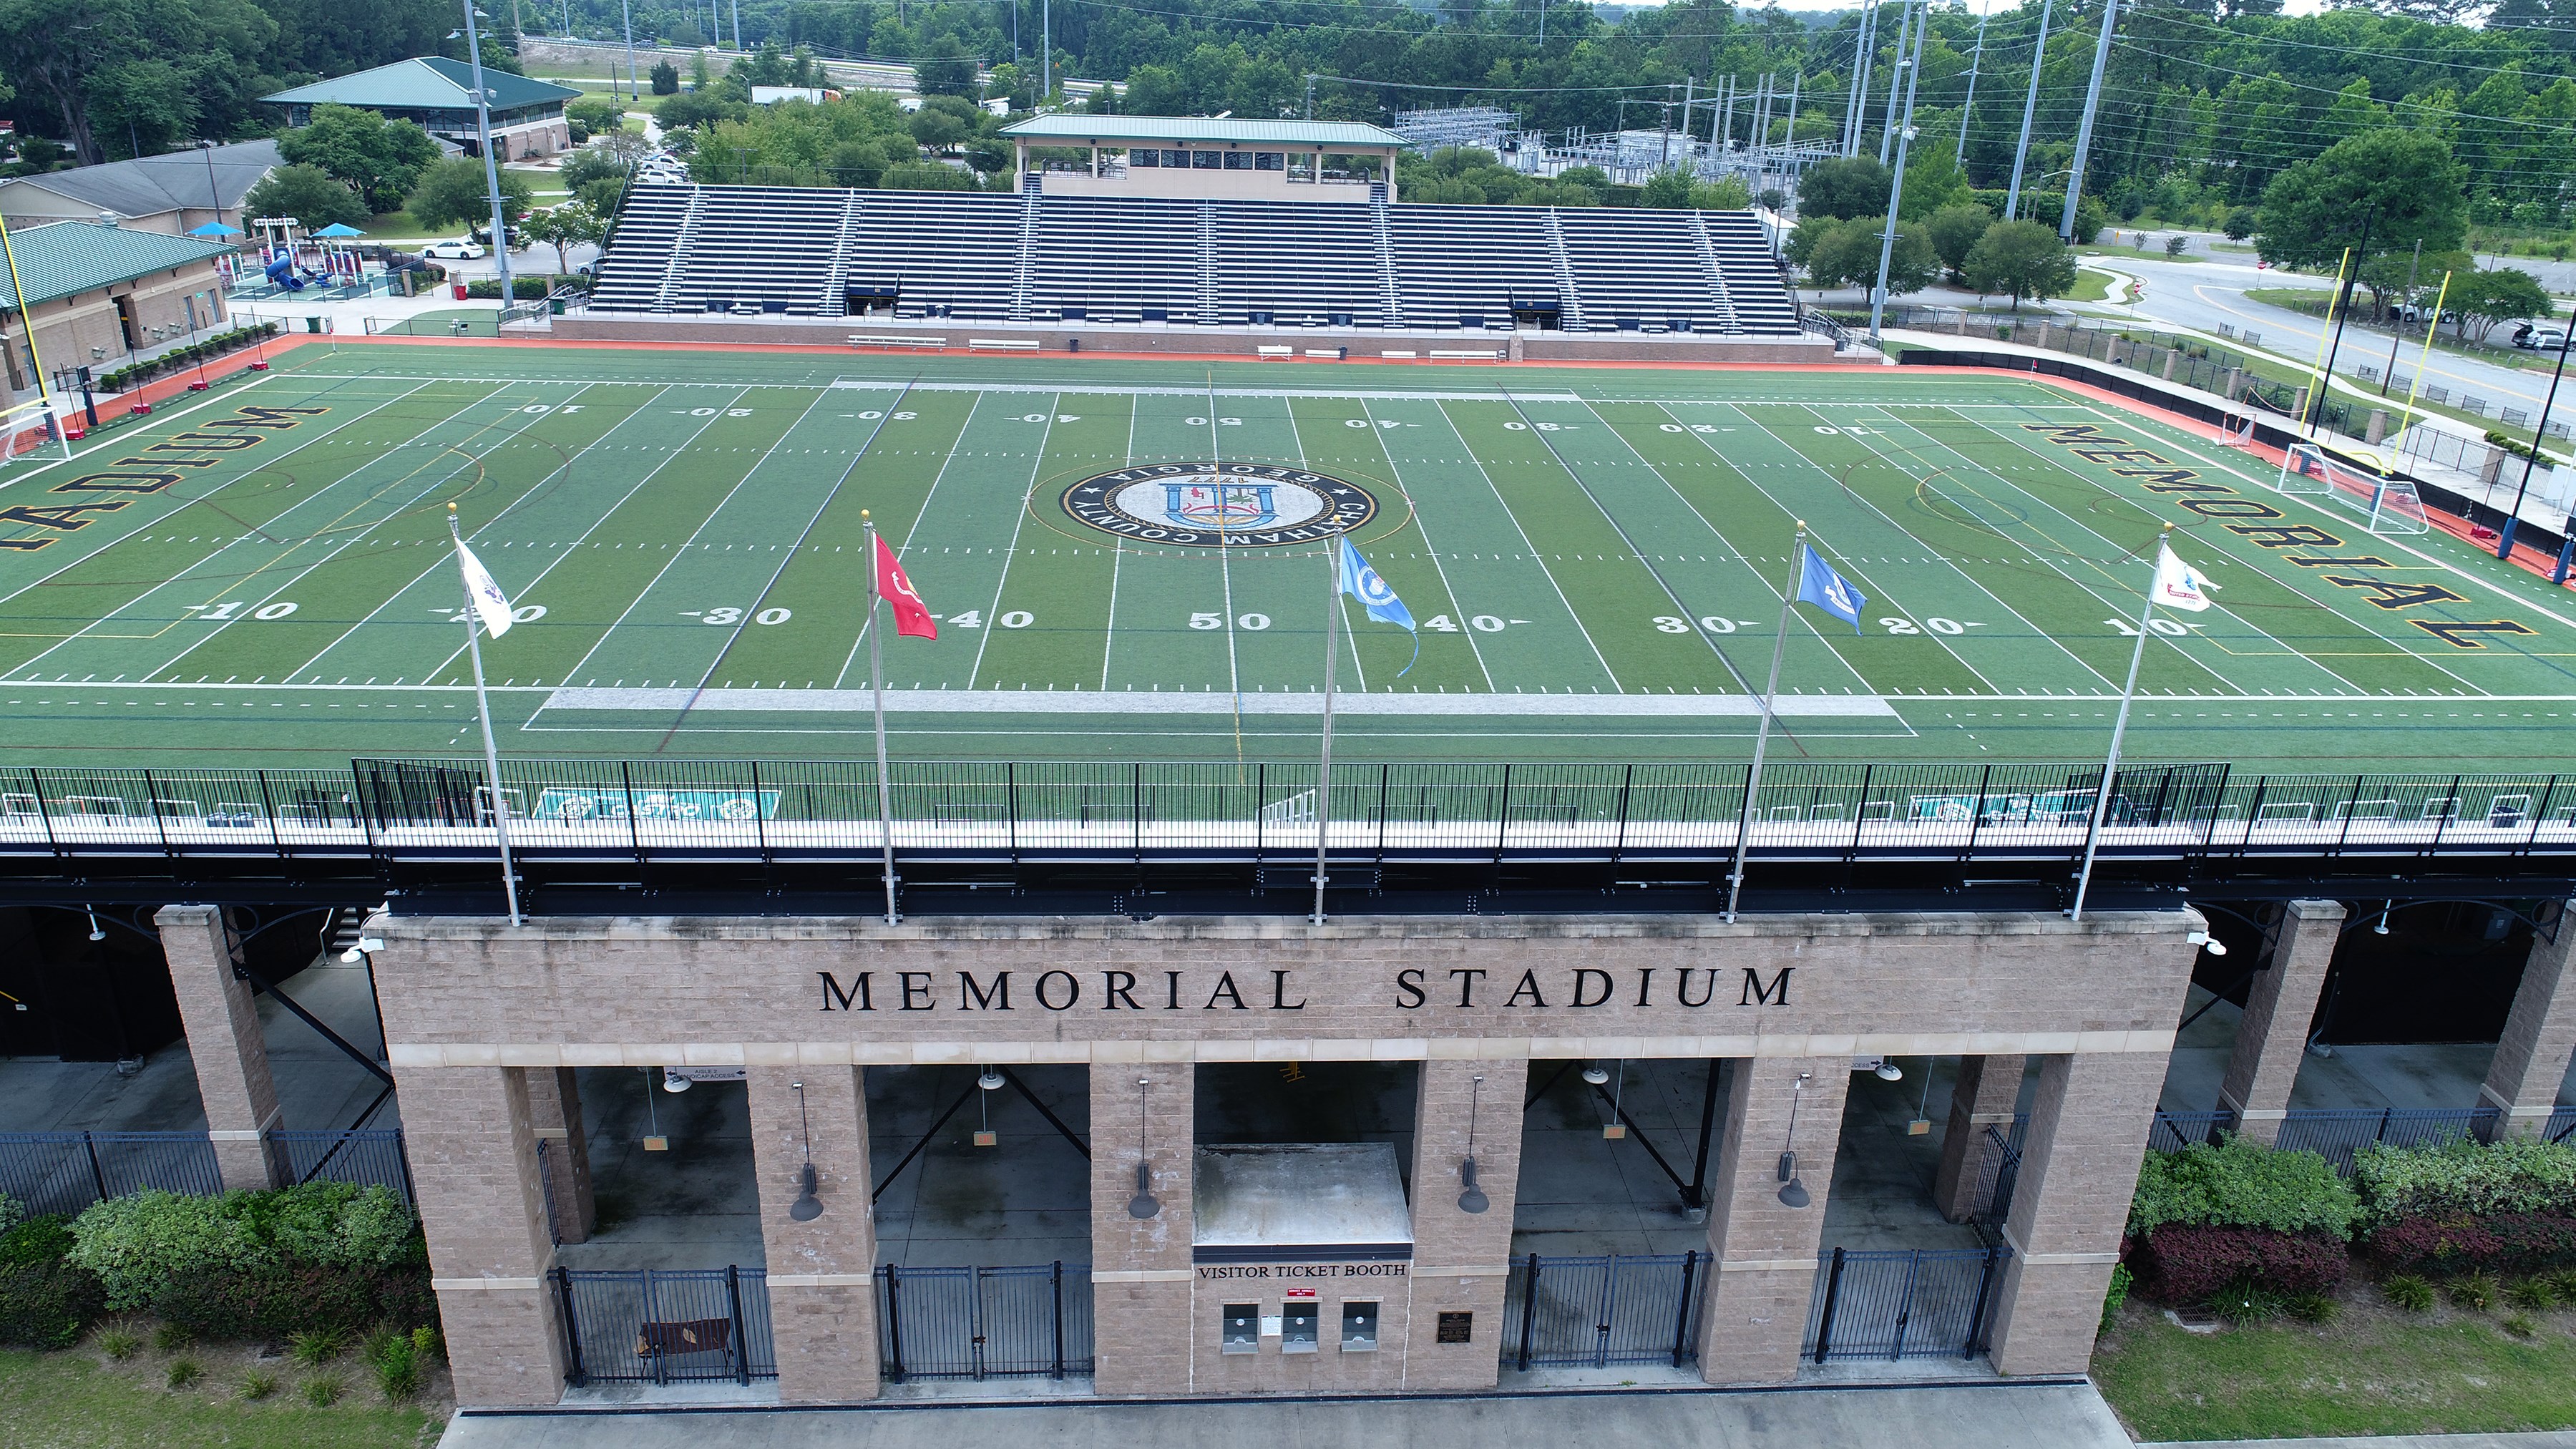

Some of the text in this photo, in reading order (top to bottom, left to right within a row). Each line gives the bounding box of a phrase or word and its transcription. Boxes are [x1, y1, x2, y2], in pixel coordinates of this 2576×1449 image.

[0, 406, 332, 551] ADIUM
[1106, 464, 1320, 482] GEORGIA
[1074, 501, 1366, 545] CHATHAM COUNTY
[2018, 424, 2540, 649] MEMORIAL
[816, 967, 1796, 1012] MEMORIAL STADIUM
[1199, 1264, 1407, 1279] VISITOR TICKET BOOTH
